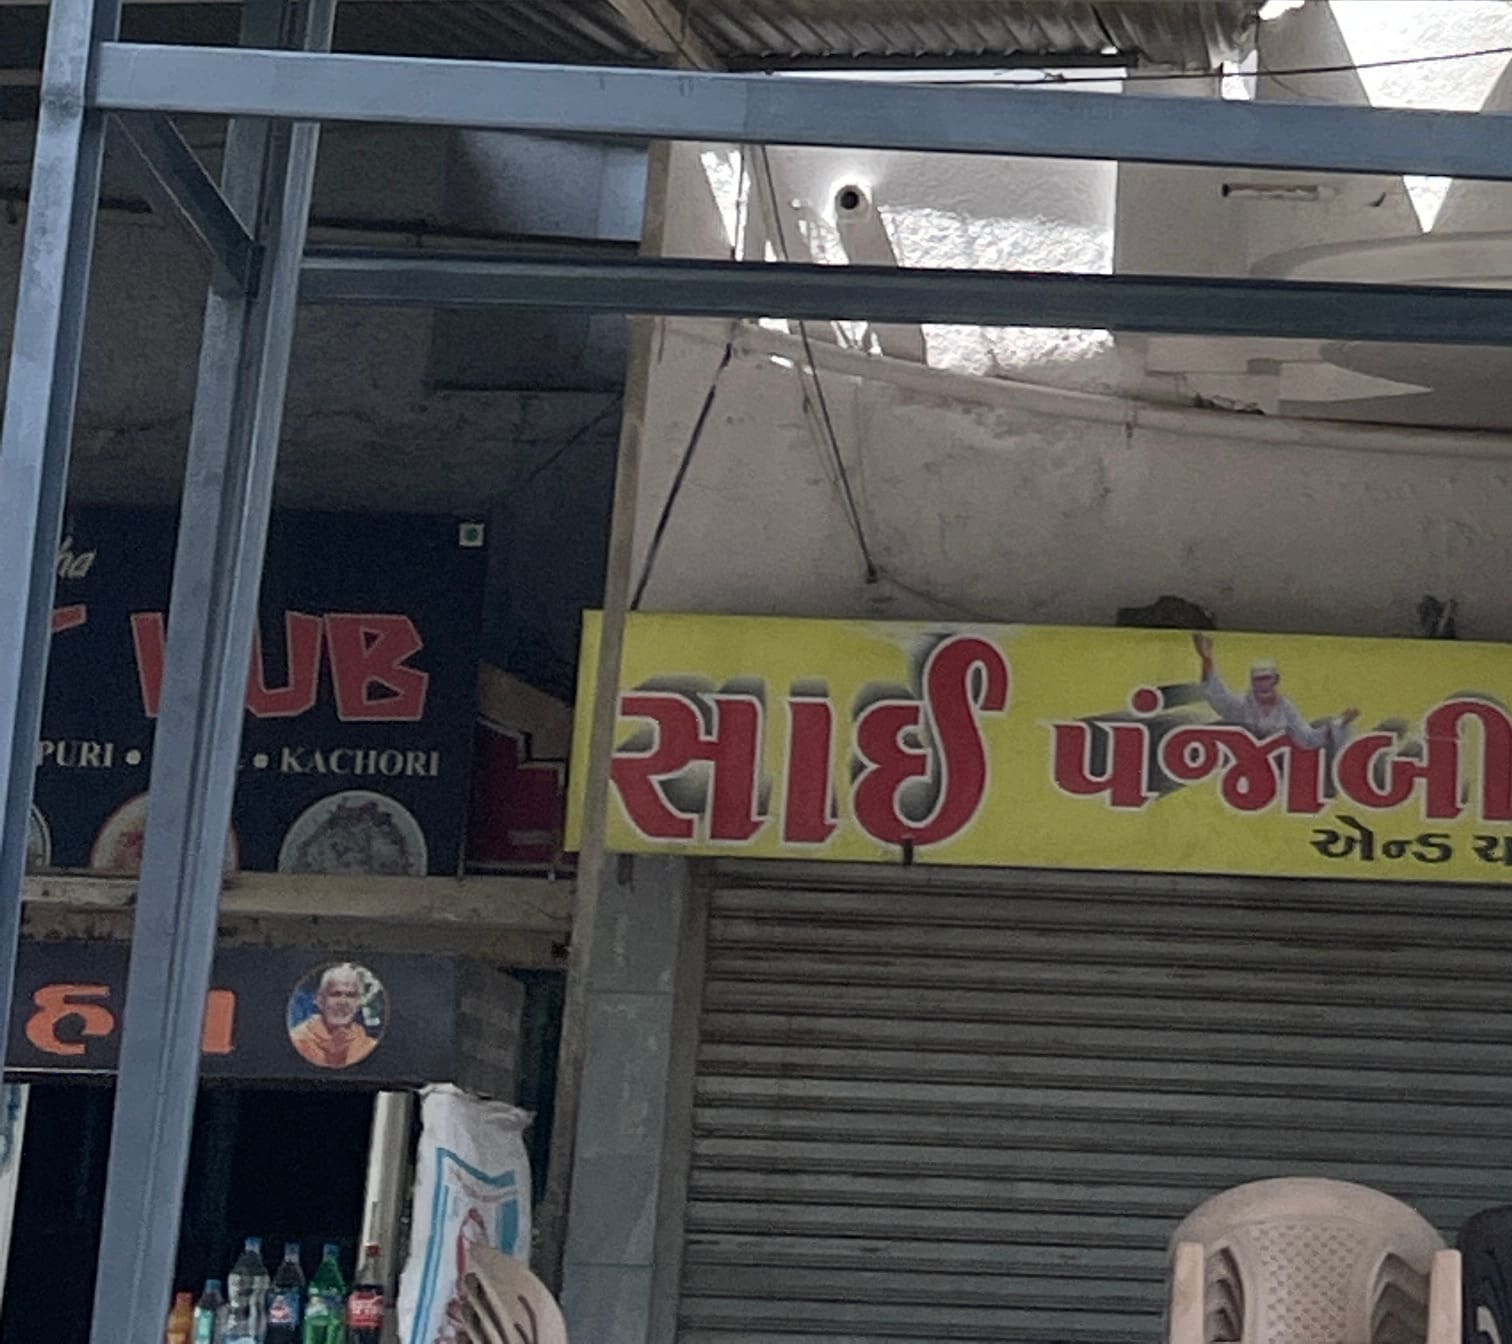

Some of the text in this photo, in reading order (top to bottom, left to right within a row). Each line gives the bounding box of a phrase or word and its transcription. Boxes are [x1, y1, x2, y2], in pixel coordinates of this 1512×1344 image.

[281, 746, 440, 777] KACHORI
[610, 633, 1011, 848] સાઈ
[1310, 814, 1453, 863] એન્ડ
